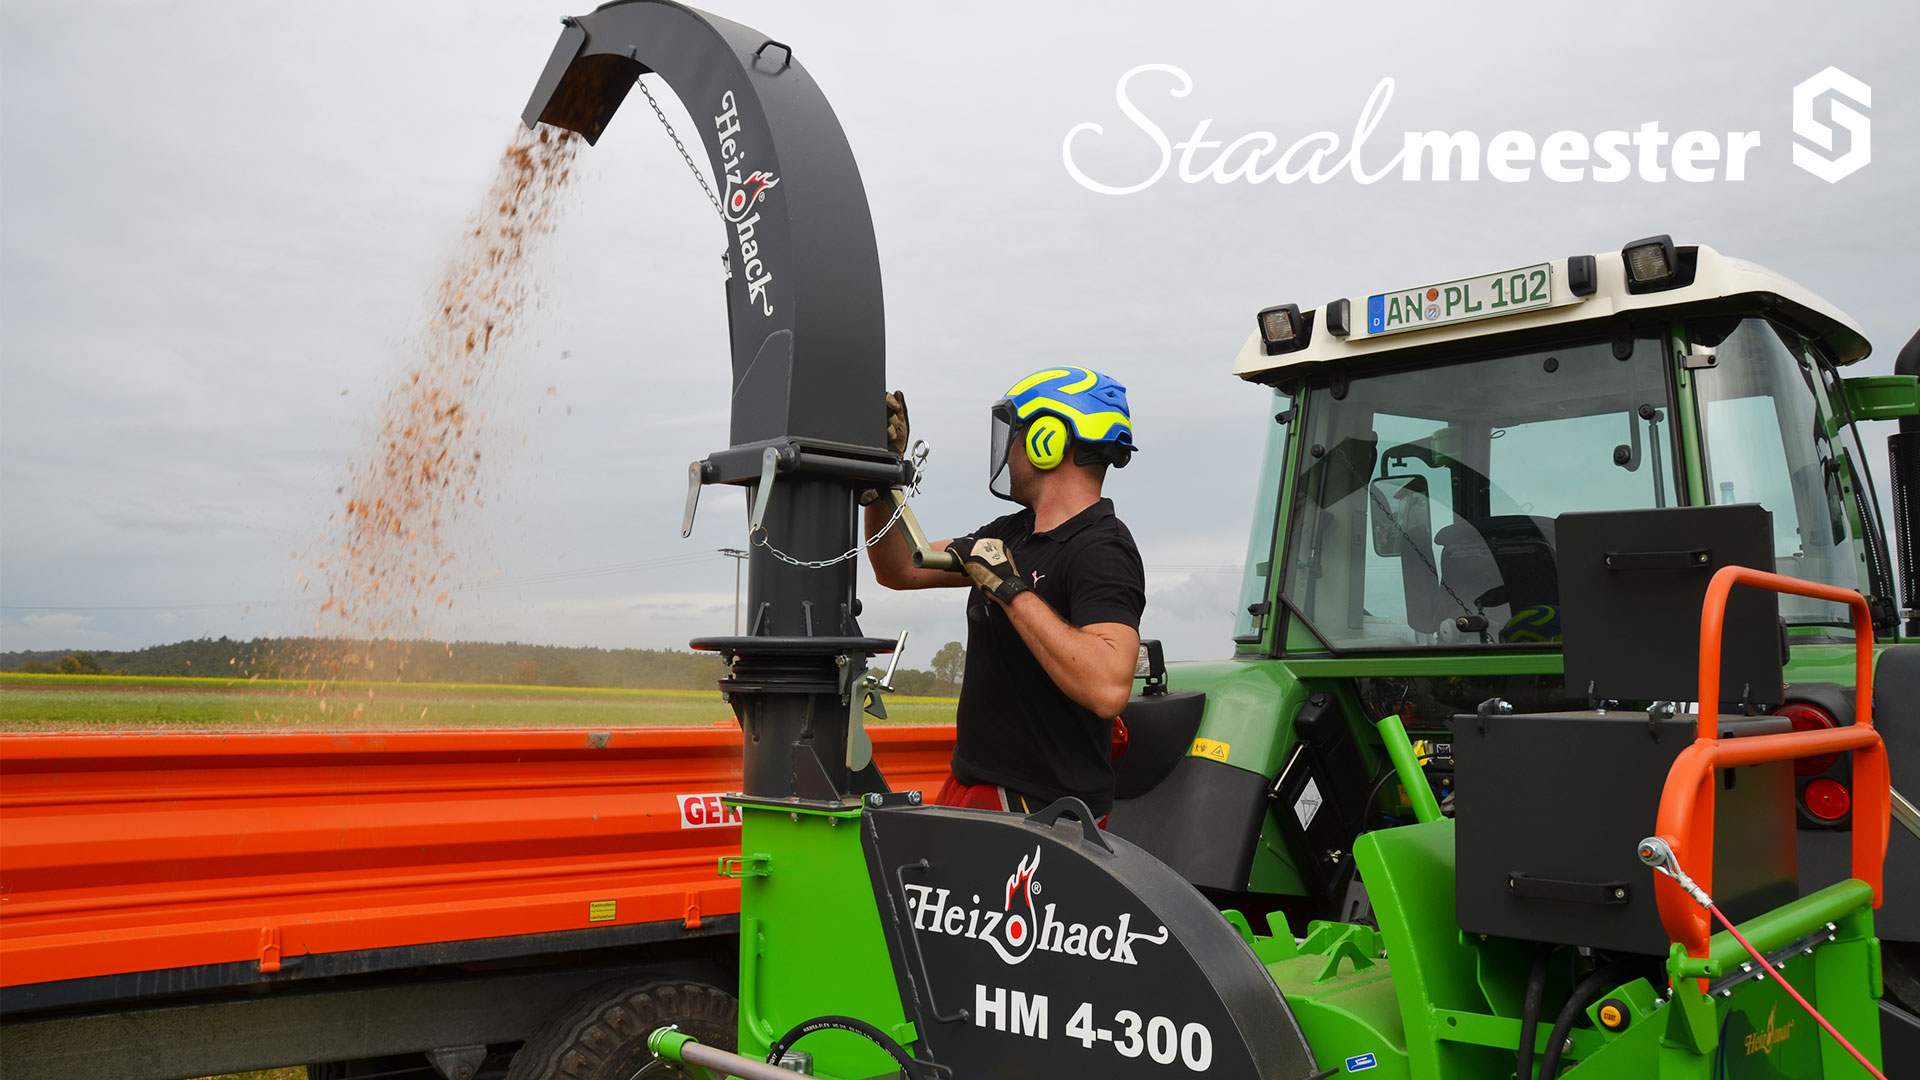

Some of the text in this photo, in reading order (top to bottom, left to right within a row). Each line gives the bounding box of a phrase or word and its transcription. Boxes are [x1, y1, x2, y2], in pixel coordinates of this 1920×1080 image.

[1373, 317, 1380, 327] D
[1387, 270, 1547, 326] AN PL 102
[975, 984, 1213, 1072] HM 4-300
